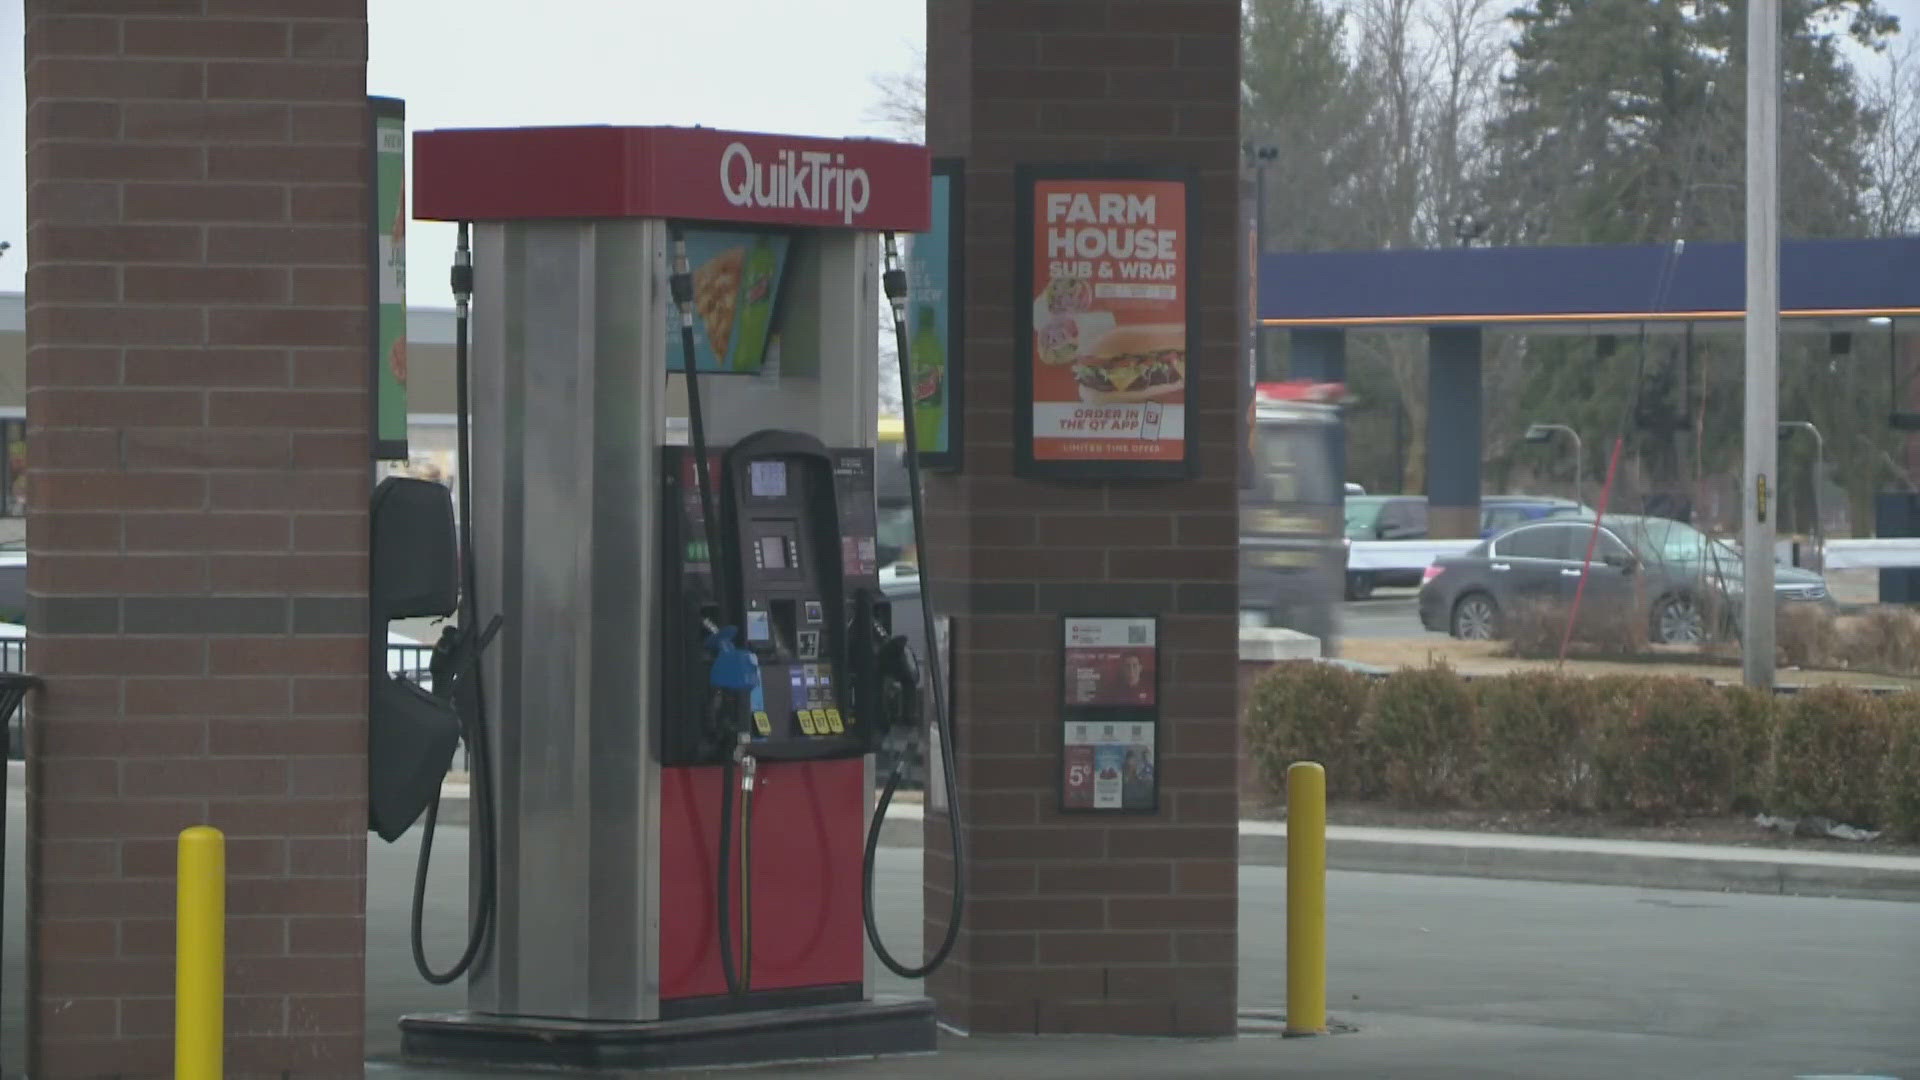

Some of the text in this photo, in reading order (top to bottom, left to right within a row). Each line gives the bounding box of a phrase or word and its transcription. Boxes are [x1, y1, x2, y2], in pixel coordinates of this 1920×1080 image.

[720, 142, 870, 224] QuikTrip
[1047, 193, 1156, 224] FARM
[1048, 228, 1177, 260] HOUSE
[1049, 261, 1177, 281] SUB & WRAP
[1074, 409, 1139, 419] ORDER IN
[1059, 419, 1139, 431] THE QT APP
[1106, 444, 1129, 453] TIME
[1131, 444, 1160, 453] OFFER
